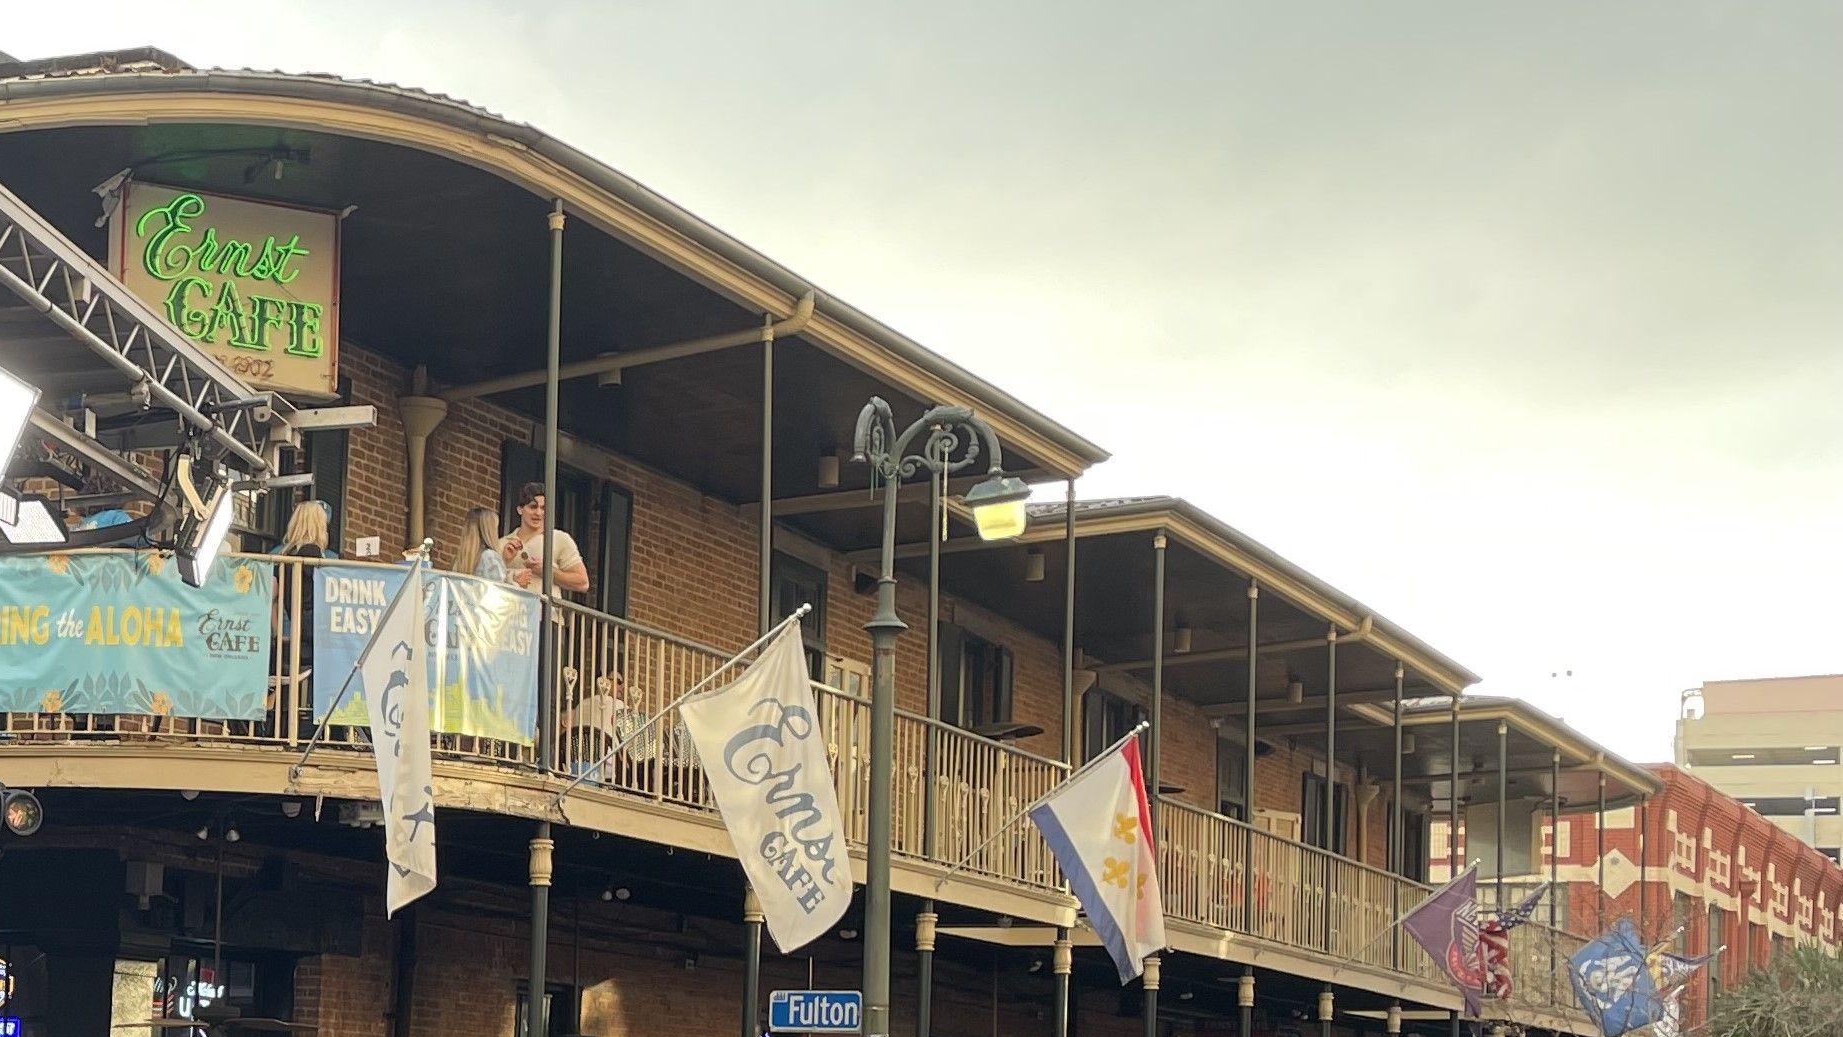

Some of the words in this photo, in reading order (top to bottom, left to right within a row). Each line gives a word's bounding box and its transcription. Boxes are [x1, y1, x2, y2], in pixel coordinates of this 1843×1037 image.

[137, 193, 309, 284] Ernst
[162, 277, 324, 359] CAFE
[325, 577, 387, 606] DRINK
[56, 608, 84, 639] the
[85, 605, 184, 647] ALOHA
[197, 608, 253, 636] Ernst
[330, 607, 384, 636] EASY
[205, 632, 260, 653] CAFE
[759, 831, 827, 915] CAFE
[789, 995, 858, 1026] Fulton
